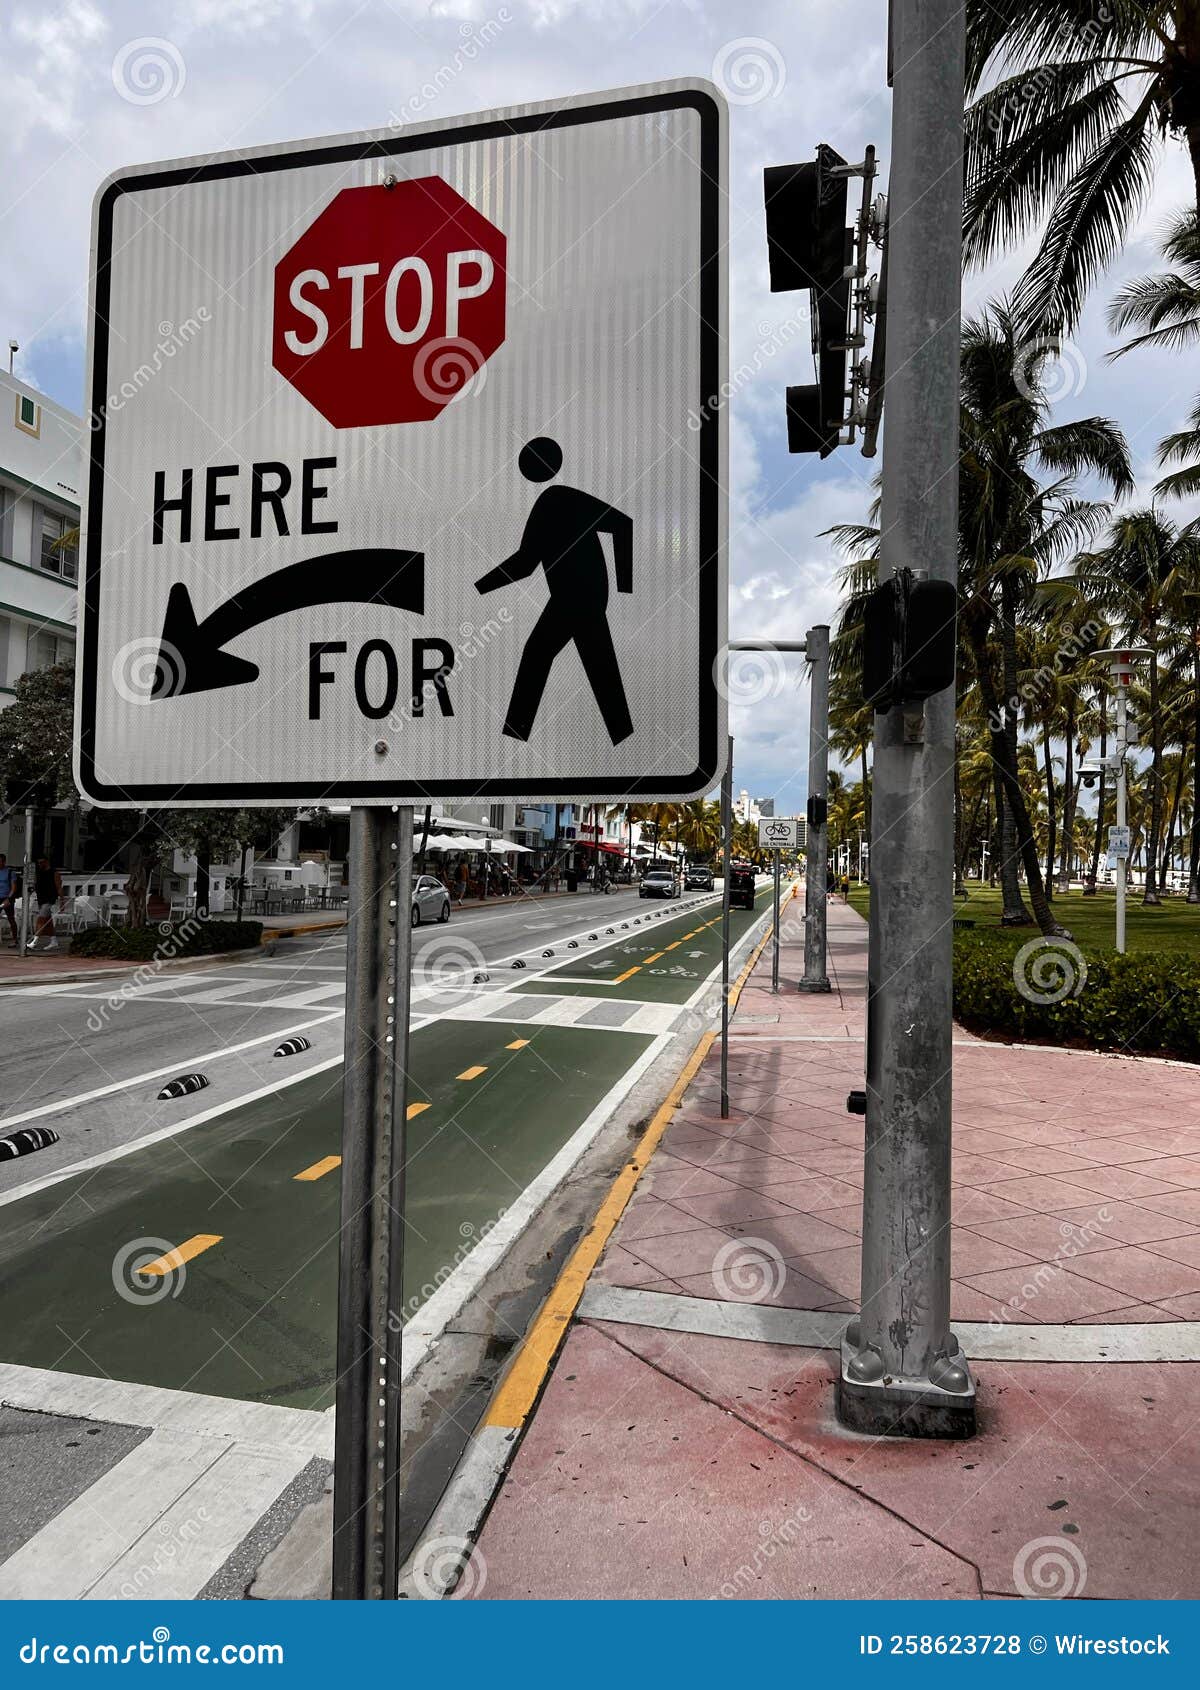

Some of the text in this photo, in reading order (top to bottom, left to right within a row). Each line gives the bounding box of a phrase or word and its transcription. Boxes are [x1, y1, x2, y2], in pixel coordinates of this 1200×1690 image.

[284, 249, 494, 356] STOP
[152, 456, 338, 545] HERE
[308, 637, 455, 720] FOR
